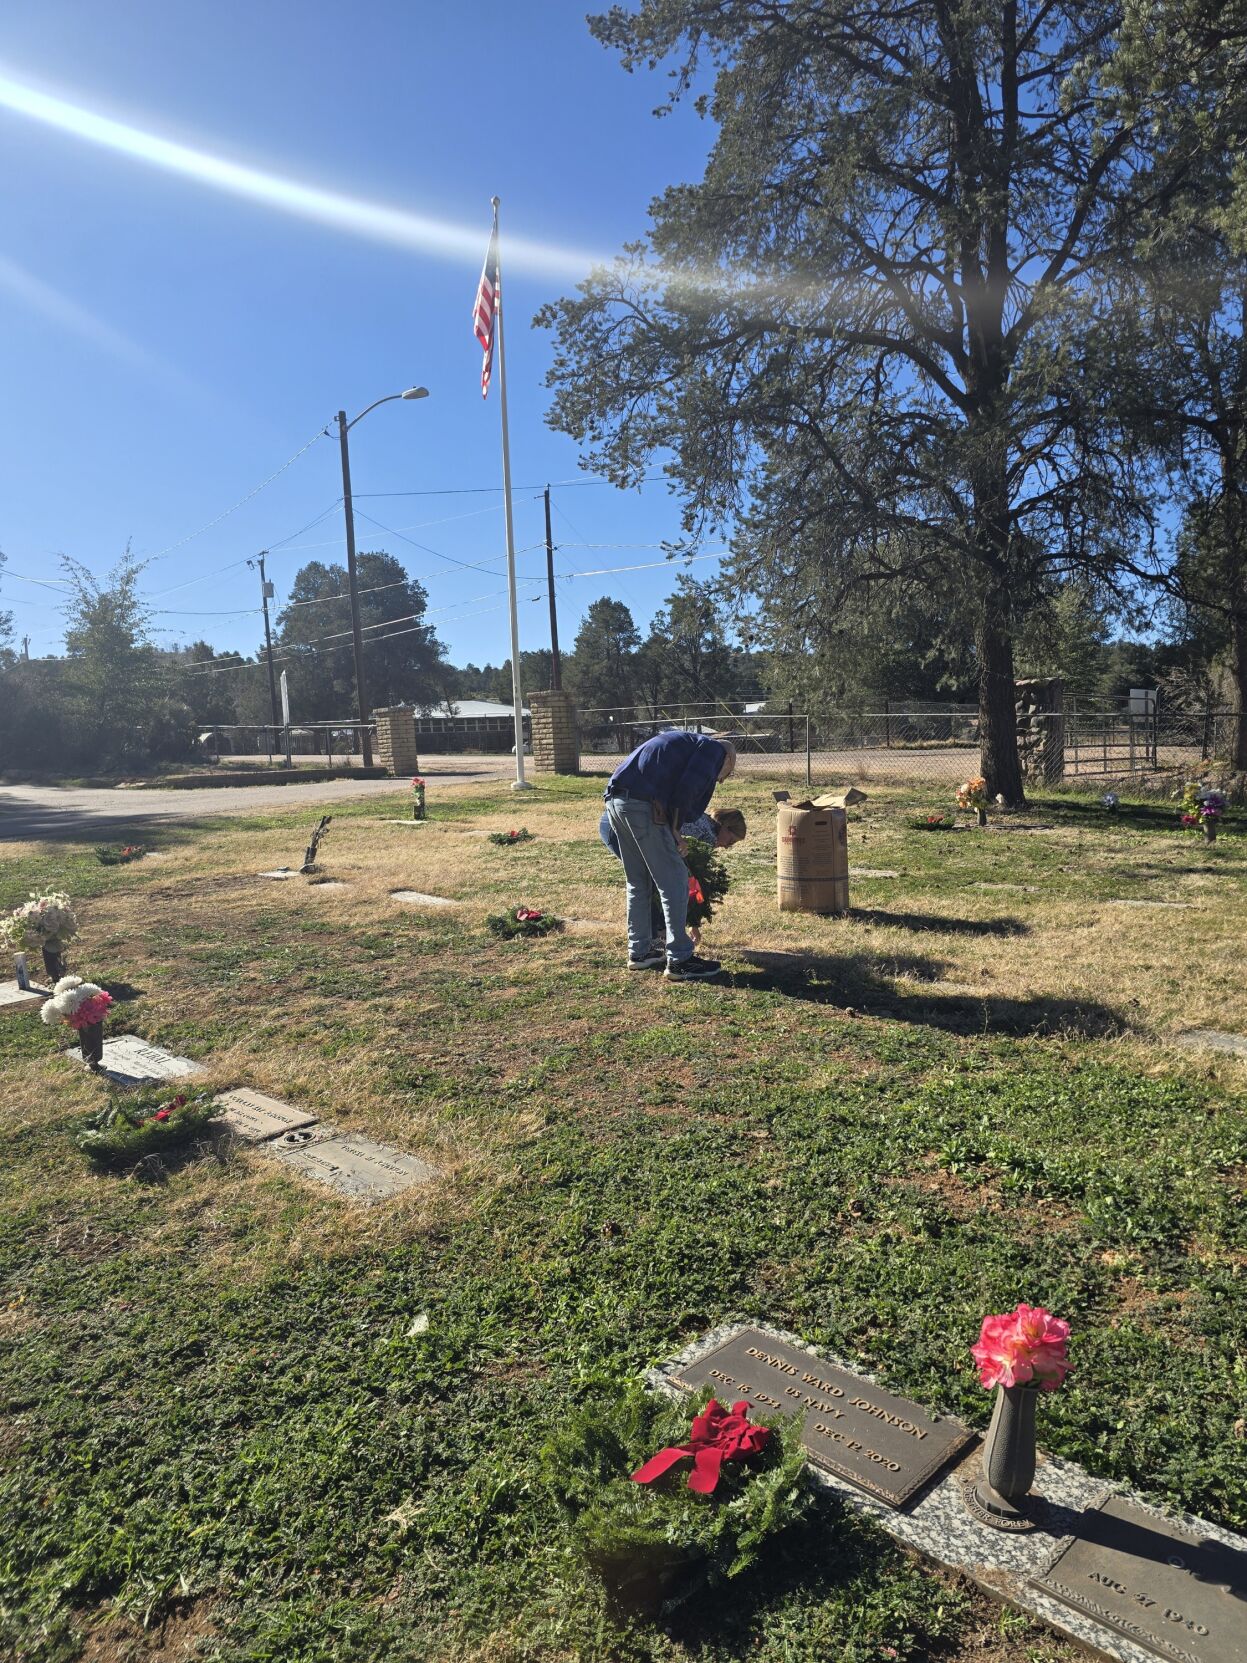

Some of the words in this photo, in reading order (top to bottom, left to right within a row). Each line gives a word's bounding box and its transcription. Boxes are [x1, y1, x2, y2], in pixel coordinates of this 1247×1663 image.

[708, 1368, 736, 1386] DEC
[736, 1383, 752, 1394] 16
[753, 1392, 782, 1410] 1934
[812, 1422, 845, 1442] DEC
[846, 1439, 863, 1453] 12
[863, 1449, 902, 1473] 2020
[745, 1346, 799, 1376] DENNIS
[801, 1372, 845, 1398] WARD
[848, 1396, 929, 1441] JOHNSON
[784, 1386, 802, 1398] US
[803, 1395, 846, 1419] NAVY
[1087, 1571, 1128, 1595] AUG
[1163, 1608, 1210, 1637] 1940
